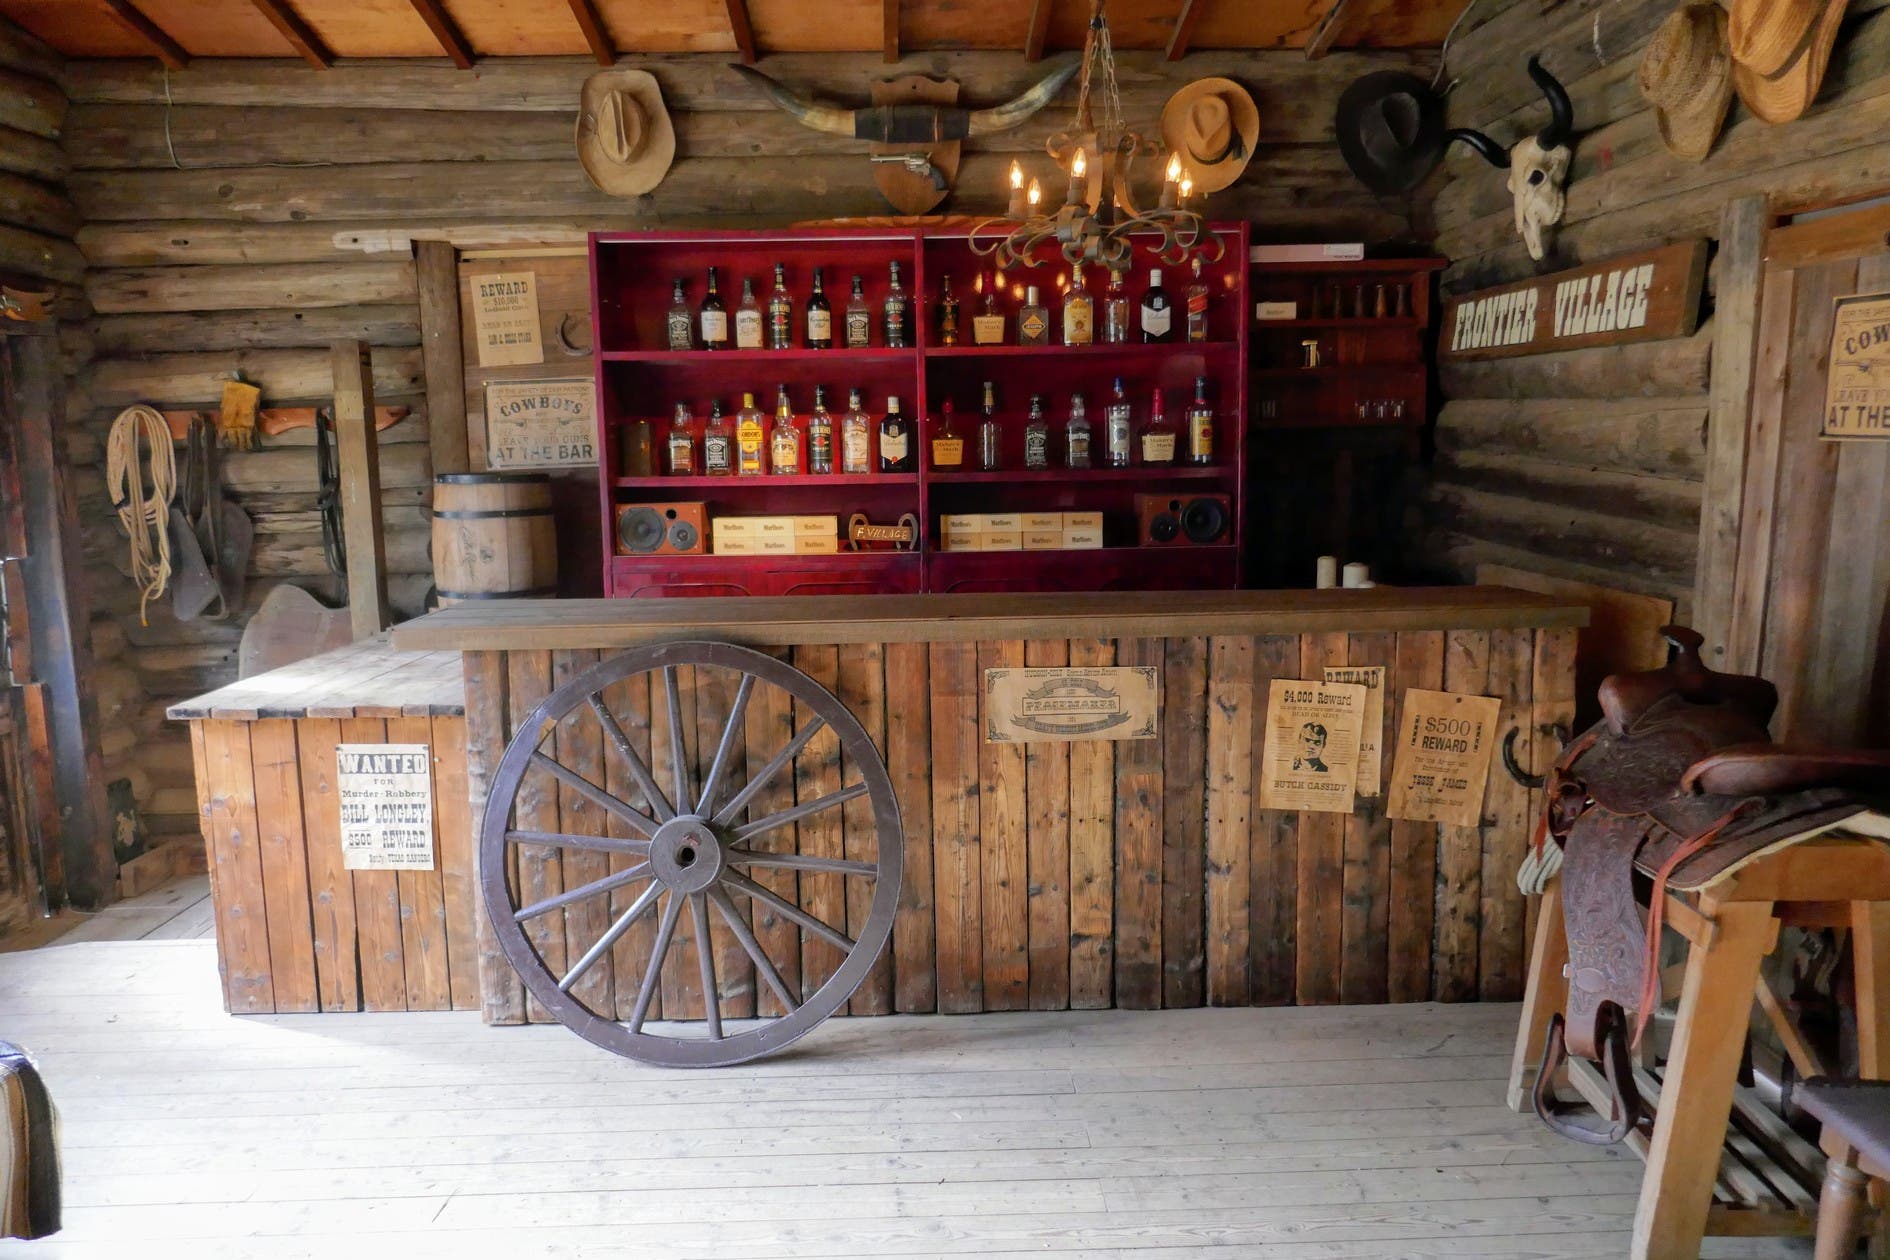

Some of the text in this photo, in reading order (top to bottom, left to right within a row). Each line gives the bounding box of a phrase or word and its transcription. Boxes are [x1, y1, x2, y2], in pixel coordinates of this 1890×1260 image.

[480, 281, 529, 298] REWARD
[1451, 263, 1655, 352] FRONTIER VILLAGE
[500, 396, 583, 417] COWBOYS
[1829, 405, 1849, 428] AT
[496, 447, 513, 460] AT
[559, 444, 592, 459] BAR
[867, 527, 908, 540] VILLAGE
[1317, 692, 1352, 706] Reward
[1425, 716, 1471, 737] $500
[1422, 735, 1468, 753] REWARD
[339, 753, 426, 774] WANTED
[1307, 782, 1348, 792] CASSIDY
[342, 803, 369, 824] BILL
[382, 830, 425, 848] REWARD
